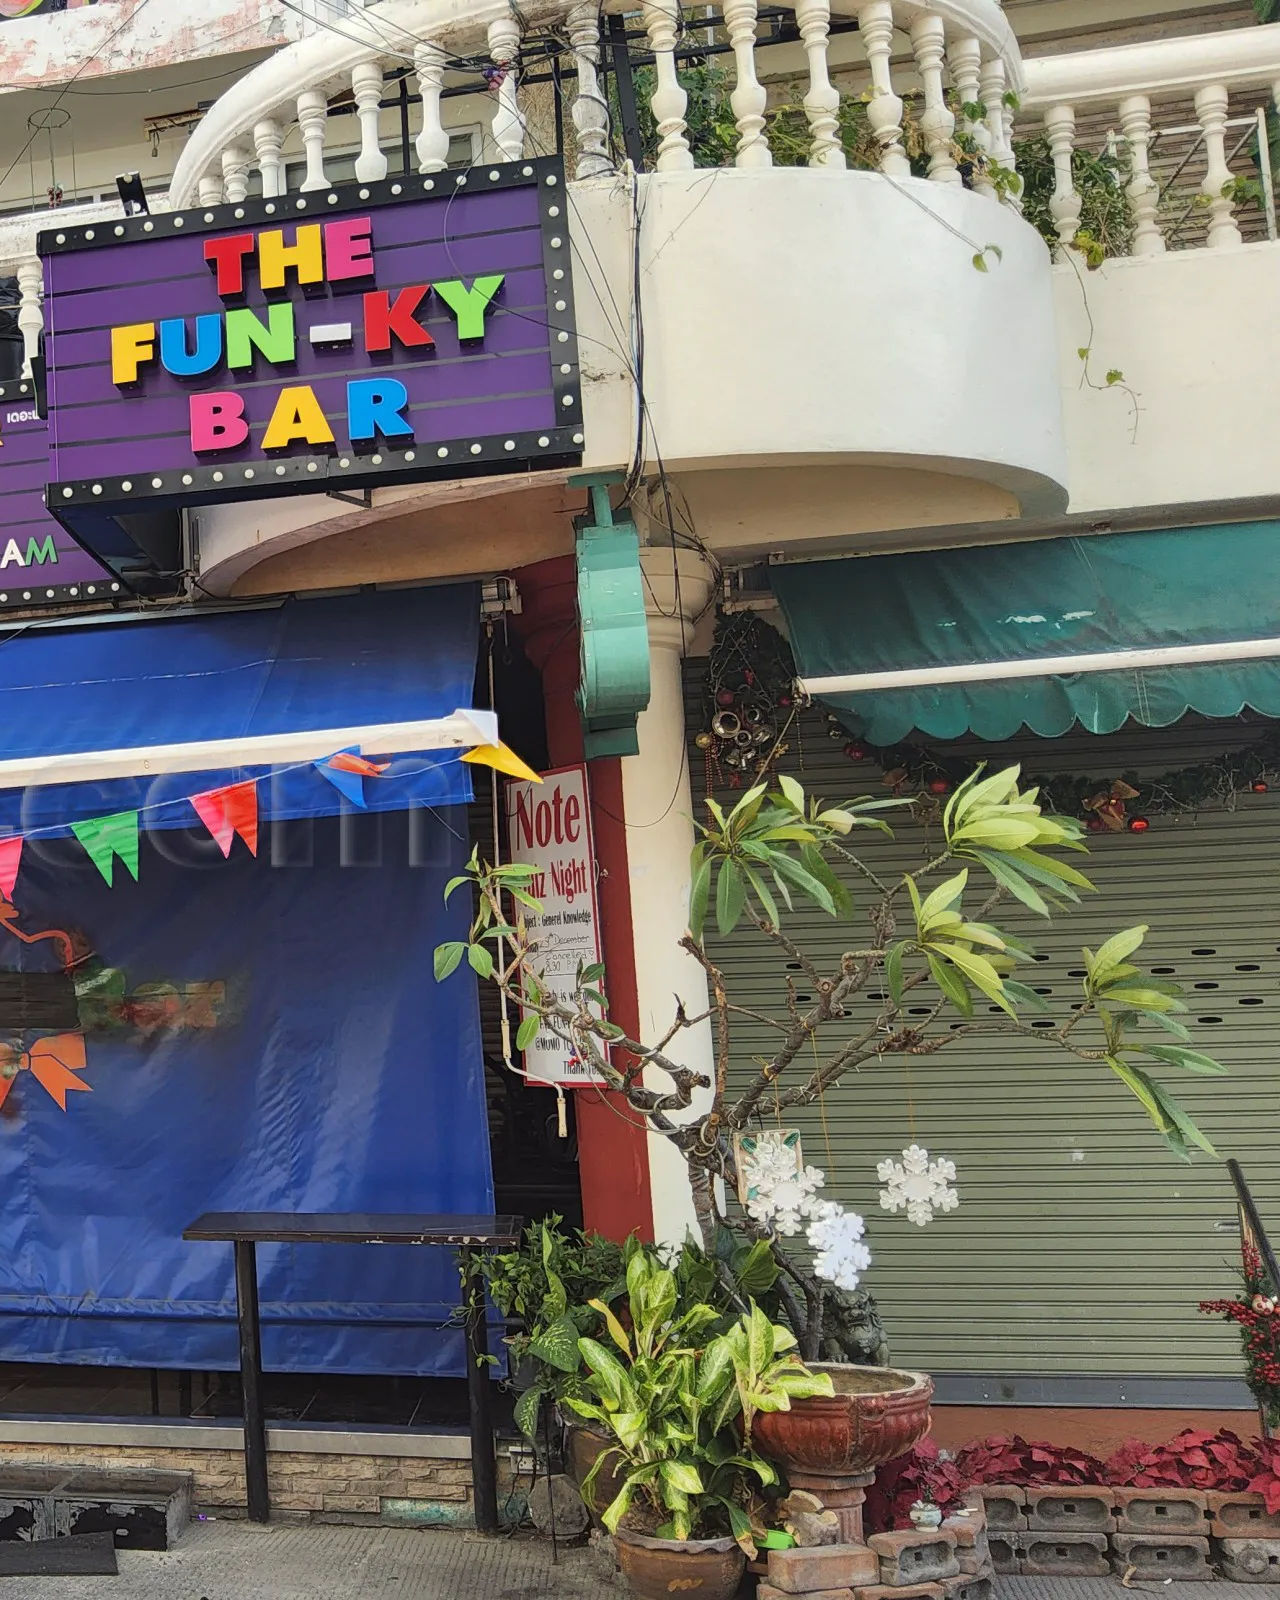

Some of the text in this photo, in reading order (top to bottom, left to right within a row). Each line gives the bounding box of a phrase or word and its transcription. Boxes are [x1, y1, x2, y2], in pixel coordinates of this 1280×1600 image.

[203, 217, 373, 296] THE
[111, 274, 506, 386] FUN-KY
[189, 377, 414, 452] BAR
[0, 534, 58, 570] AM
[516, 785, 581, 851] Note
[550, 857, 588, 904] Night
[562, 908, 592, 927] Knowledge
